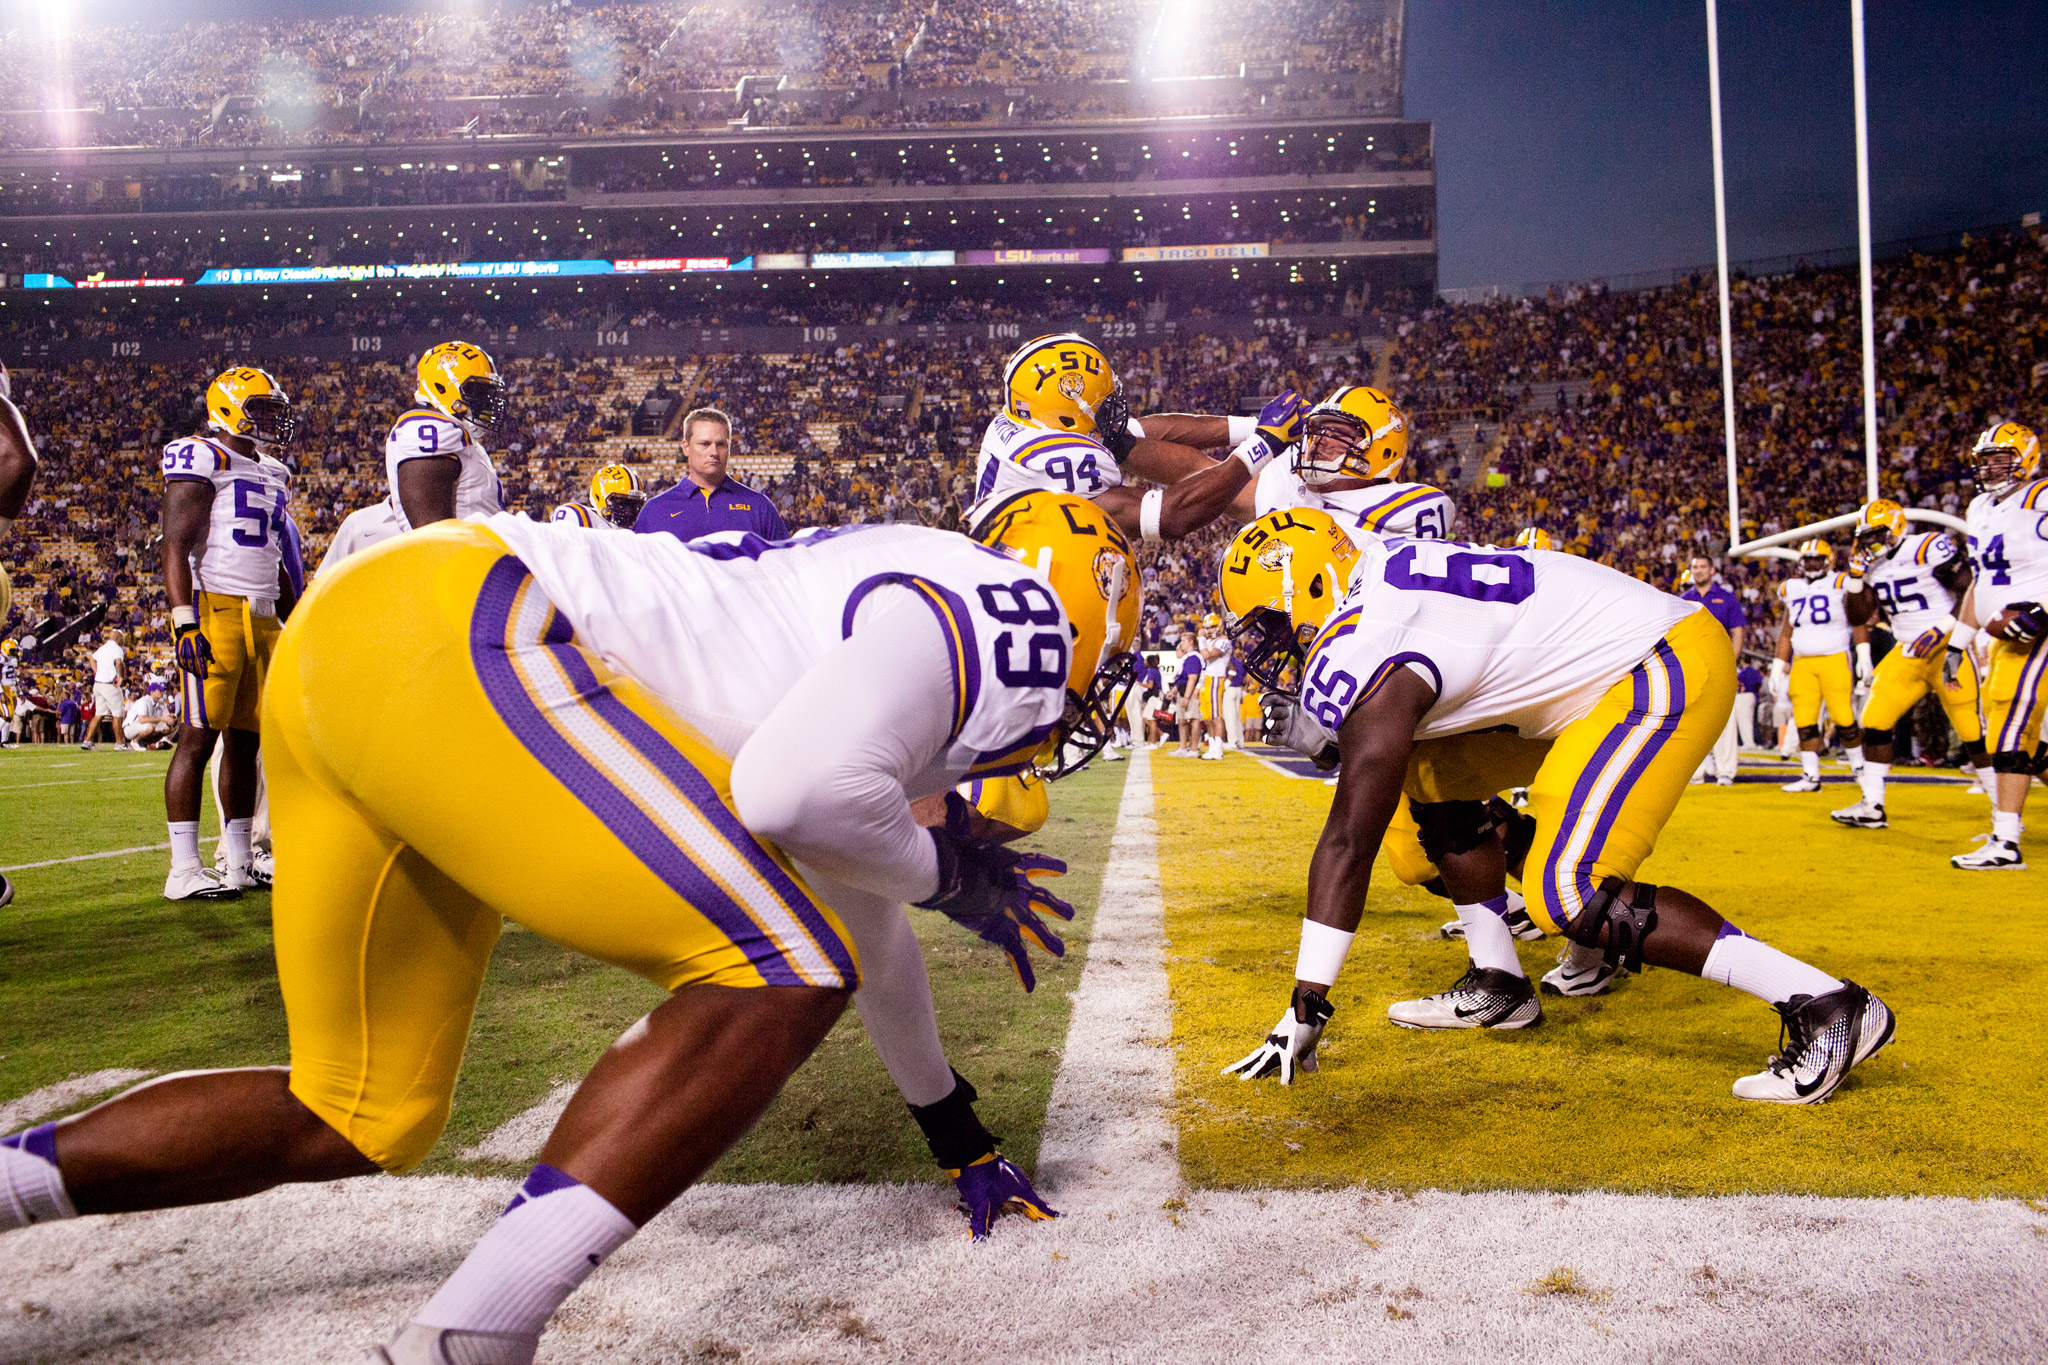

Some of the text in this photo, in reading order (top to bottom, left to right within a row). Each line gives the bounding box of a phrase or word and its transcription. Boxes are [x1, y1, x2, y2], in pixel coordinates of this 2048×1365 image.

[813, 254, 847, 265] Volvo
[1158, 248, 1208, 259] TACO
[1215, 246, 1263, 257] BELL
[254, 269, 280, 281] Row
[376, 264, 395, 277] the
[446, 262, 479, 275] Home
[481, 263, 494, 275] of
[495, 262, 520, 275] LSU
[522, 261, 559, 276] Sports
[615, 258, 728, 270] CLASSIC ROCK
[597, 330, 629, 346] 104
[803, 326, 837, 342] 105
[988, 323, 1020, 339] 106
[1102, 322, 1137, 338] 222
[111, 341, 141, 357] 102
[352, 336, 382, 352] 103
[425, 343, 479, 365] LSU
[1034, 351, 1100, 391] LSU
[418, 424, 438, 453] 9
[163, 443, 195, 470] 54
[1248, 441, 1269, 464] LSU
[1045, 454, 1102, 493] 94
[729, 503, 751, 511] LSU
[1416, 504, 1446, 539] 61
[1229, 511, 1315, 576] LSU
[1874, 577, 1929, 615] 95
[1792, 595, 1831, 627] 78
[977, 578, 1068, 688] 89
[1303, 654, 1358, 730] 65
